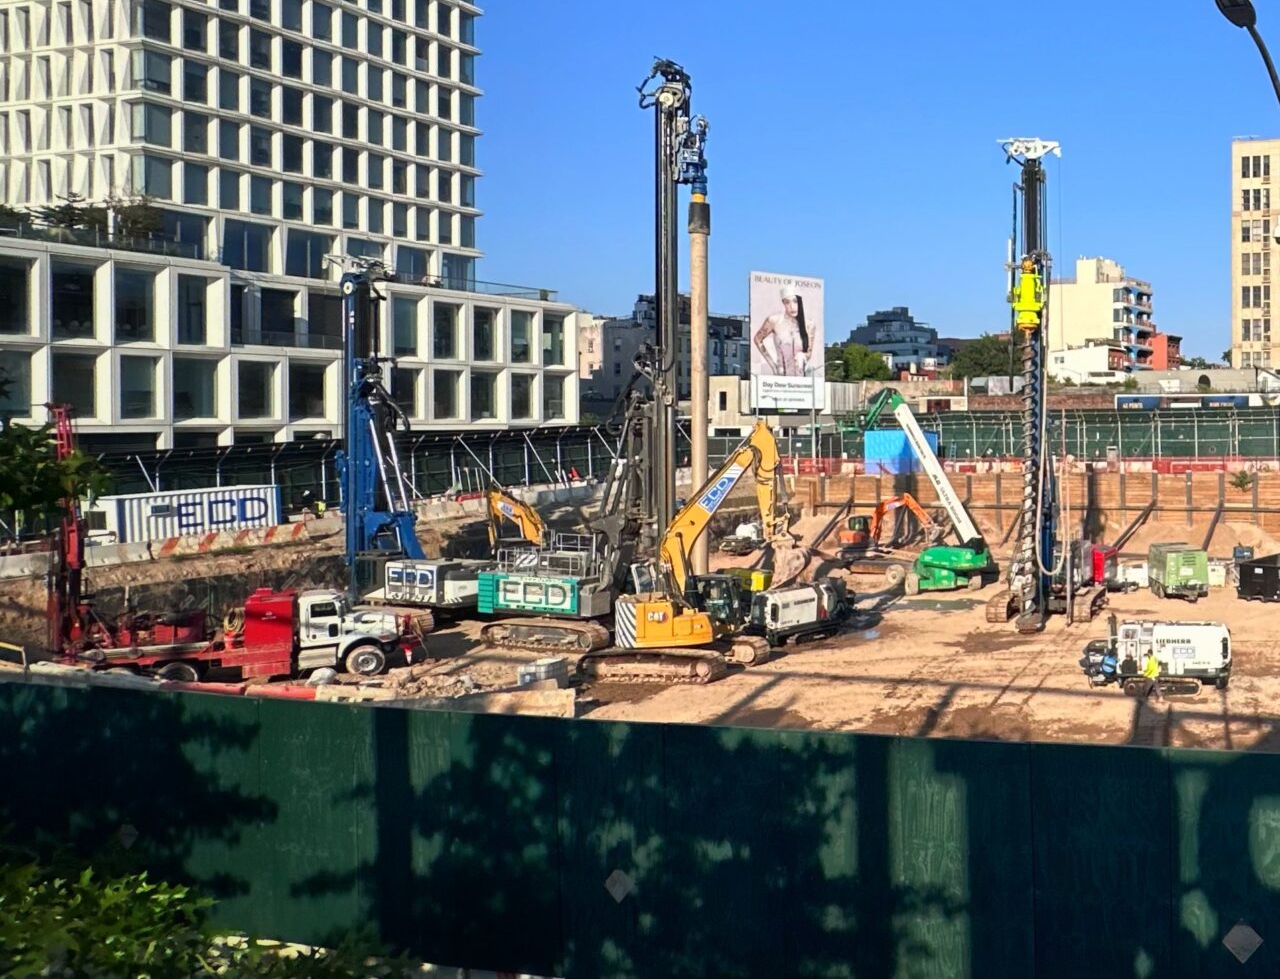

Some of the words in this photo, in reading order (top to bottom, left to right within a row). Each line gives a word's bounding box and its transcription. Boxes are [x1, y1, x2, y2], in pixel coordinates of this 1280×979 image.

[754, 274, 782, 284] BEAUTY
[783, 278, 792, 286] OF
[700, 478, 729, 509] ECD
[177, 497, 269, 529] ECD
[388, 567, 433, 588] ECD
[503, 580, 567, 606] ECD
[647, 611, 665, 622] CAT
